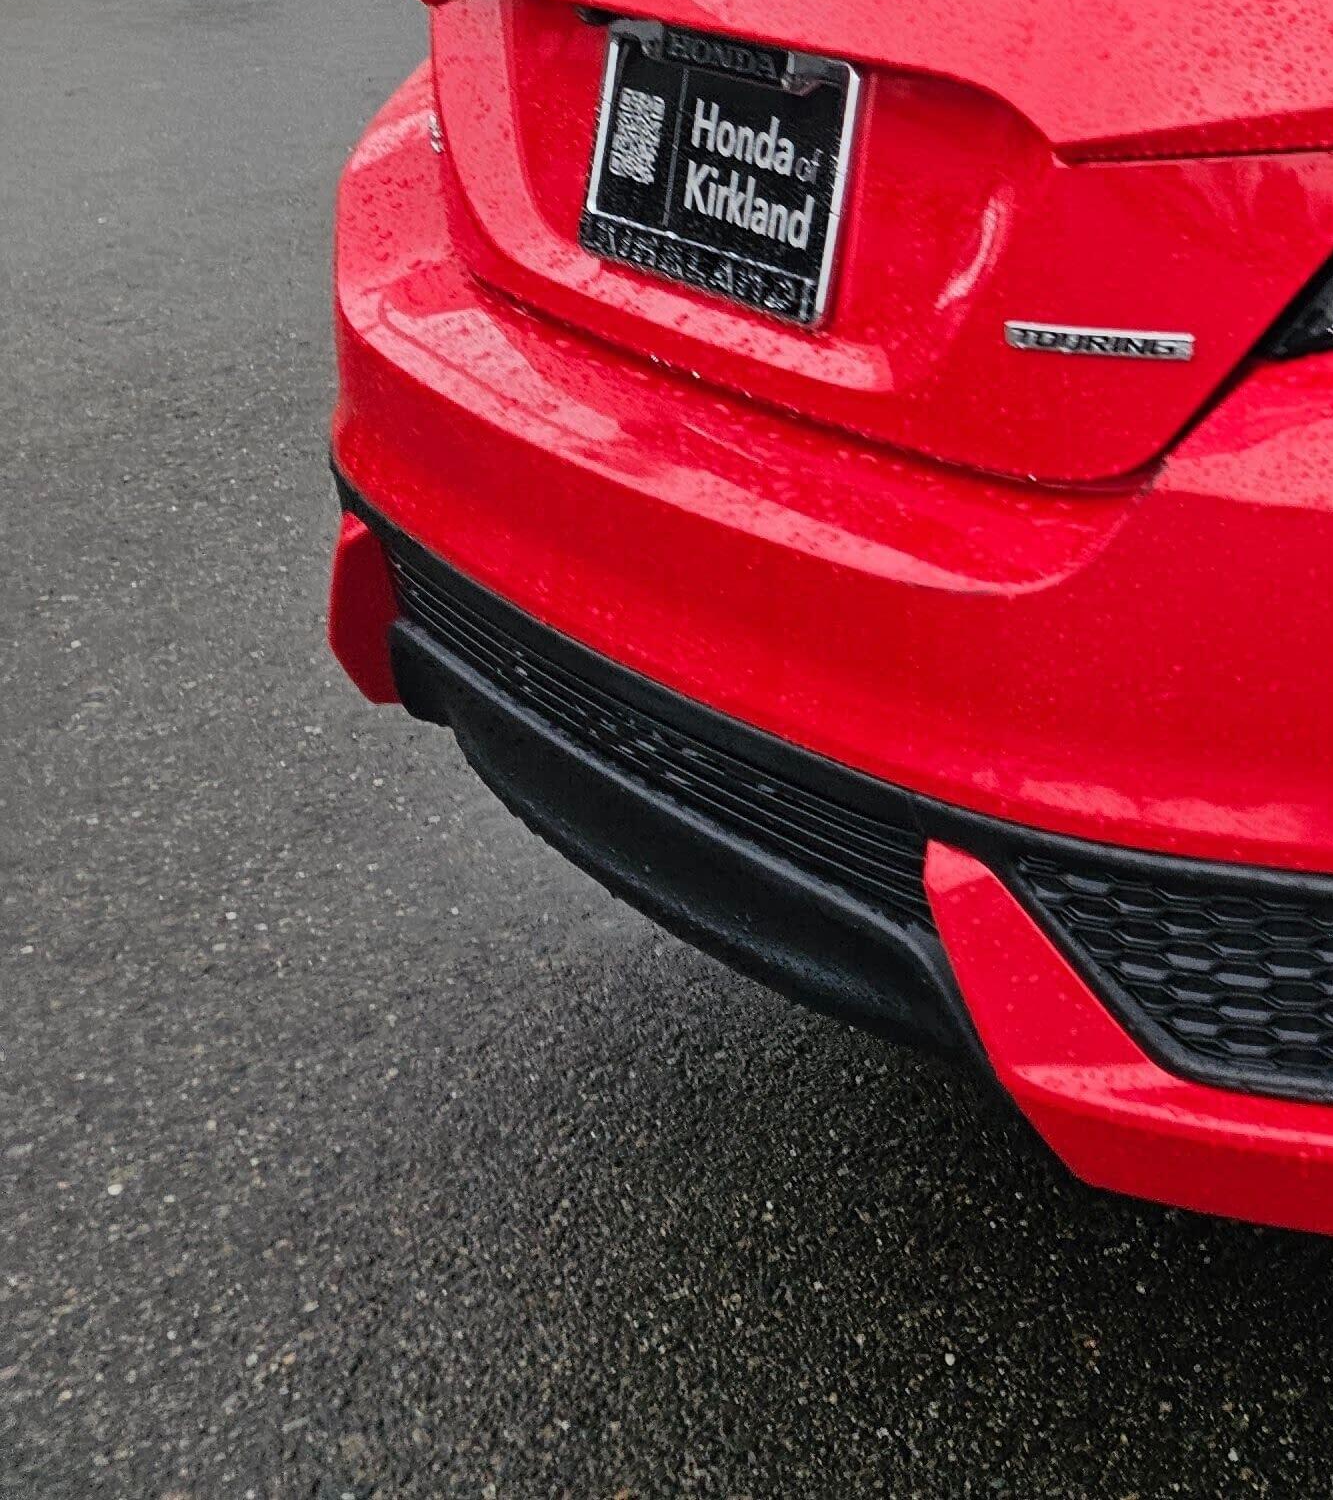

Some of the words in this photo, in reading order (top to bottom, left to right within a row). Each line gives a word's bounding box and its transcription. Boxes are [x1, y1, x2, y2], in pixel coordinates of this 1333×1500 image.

[668, 31, 778, 79] HONDA
[690, 97, 796, 177] Honda
[795, 148, 823, 184] of
[683, 158, 815, 250] Kirkland
[1007, 325, 1182, 358] TOURING
